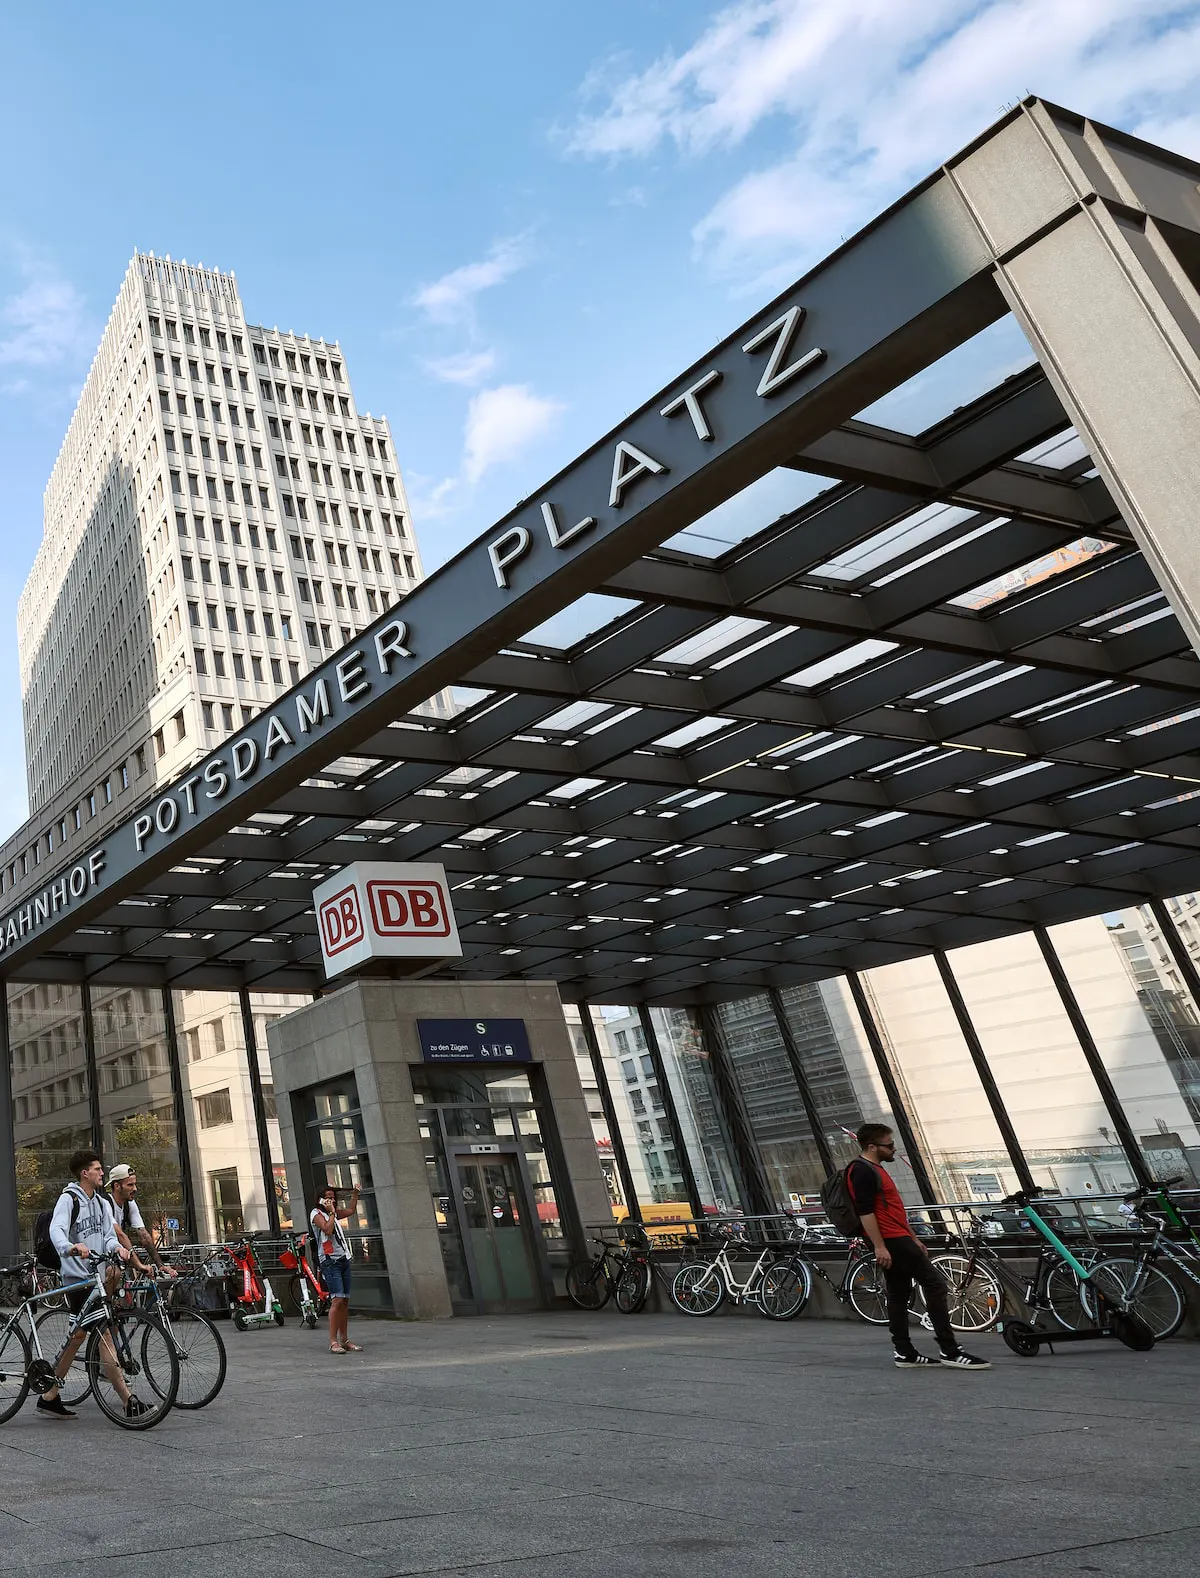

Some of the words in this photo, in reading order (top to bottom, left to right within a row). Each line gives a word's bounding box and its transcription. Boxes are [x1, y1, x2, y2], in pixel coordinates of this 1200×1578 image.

[133, 620, 416, 852] POTSDAMER
[487, 305, 828, 589] PLATZ
[325, 897, 358, 947] DB
[377, 889, 439, 928] DB
[438, 1043, 450, 1051] den
[450, 1043, 469, 1053] Zügen
[475, 1022, 486, 1035] S
